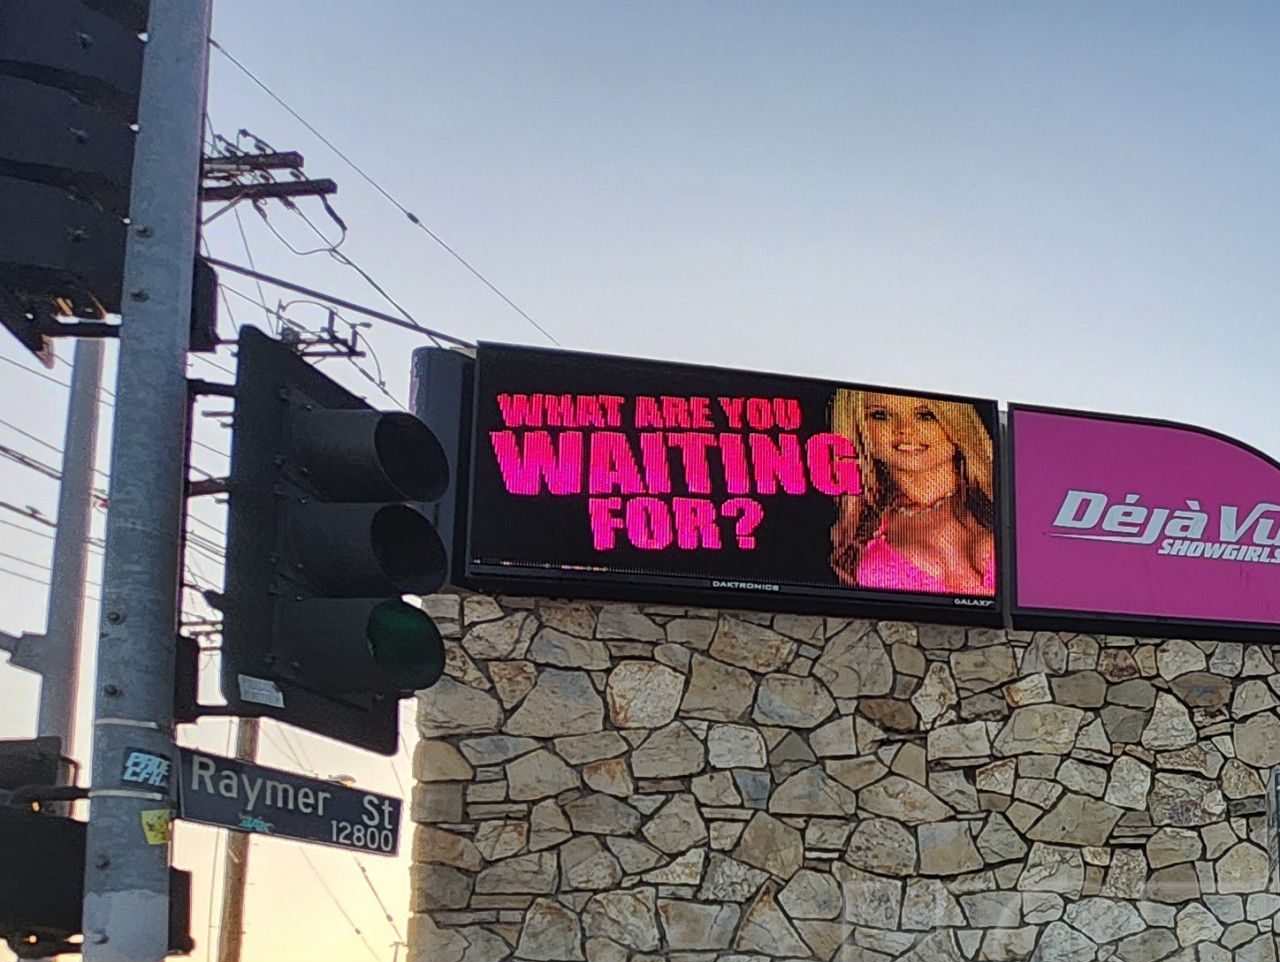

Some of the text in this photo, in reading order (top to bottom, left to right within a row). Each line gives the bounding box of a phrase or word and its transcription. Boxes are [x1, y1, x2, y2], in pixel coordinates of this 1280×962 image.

[496, 393, 802, 431] WHAT ARE YOU
[489, 430, 863, 496] WAITING
[588, 497, 765, 550] FOR?
[1051, 489, 1209, 546] Déjà
[711, 580, 780, 592] DAKTRONICS
[191, 754, 394, 831] Raymer St
[331, 819, 394, 852] 12800
